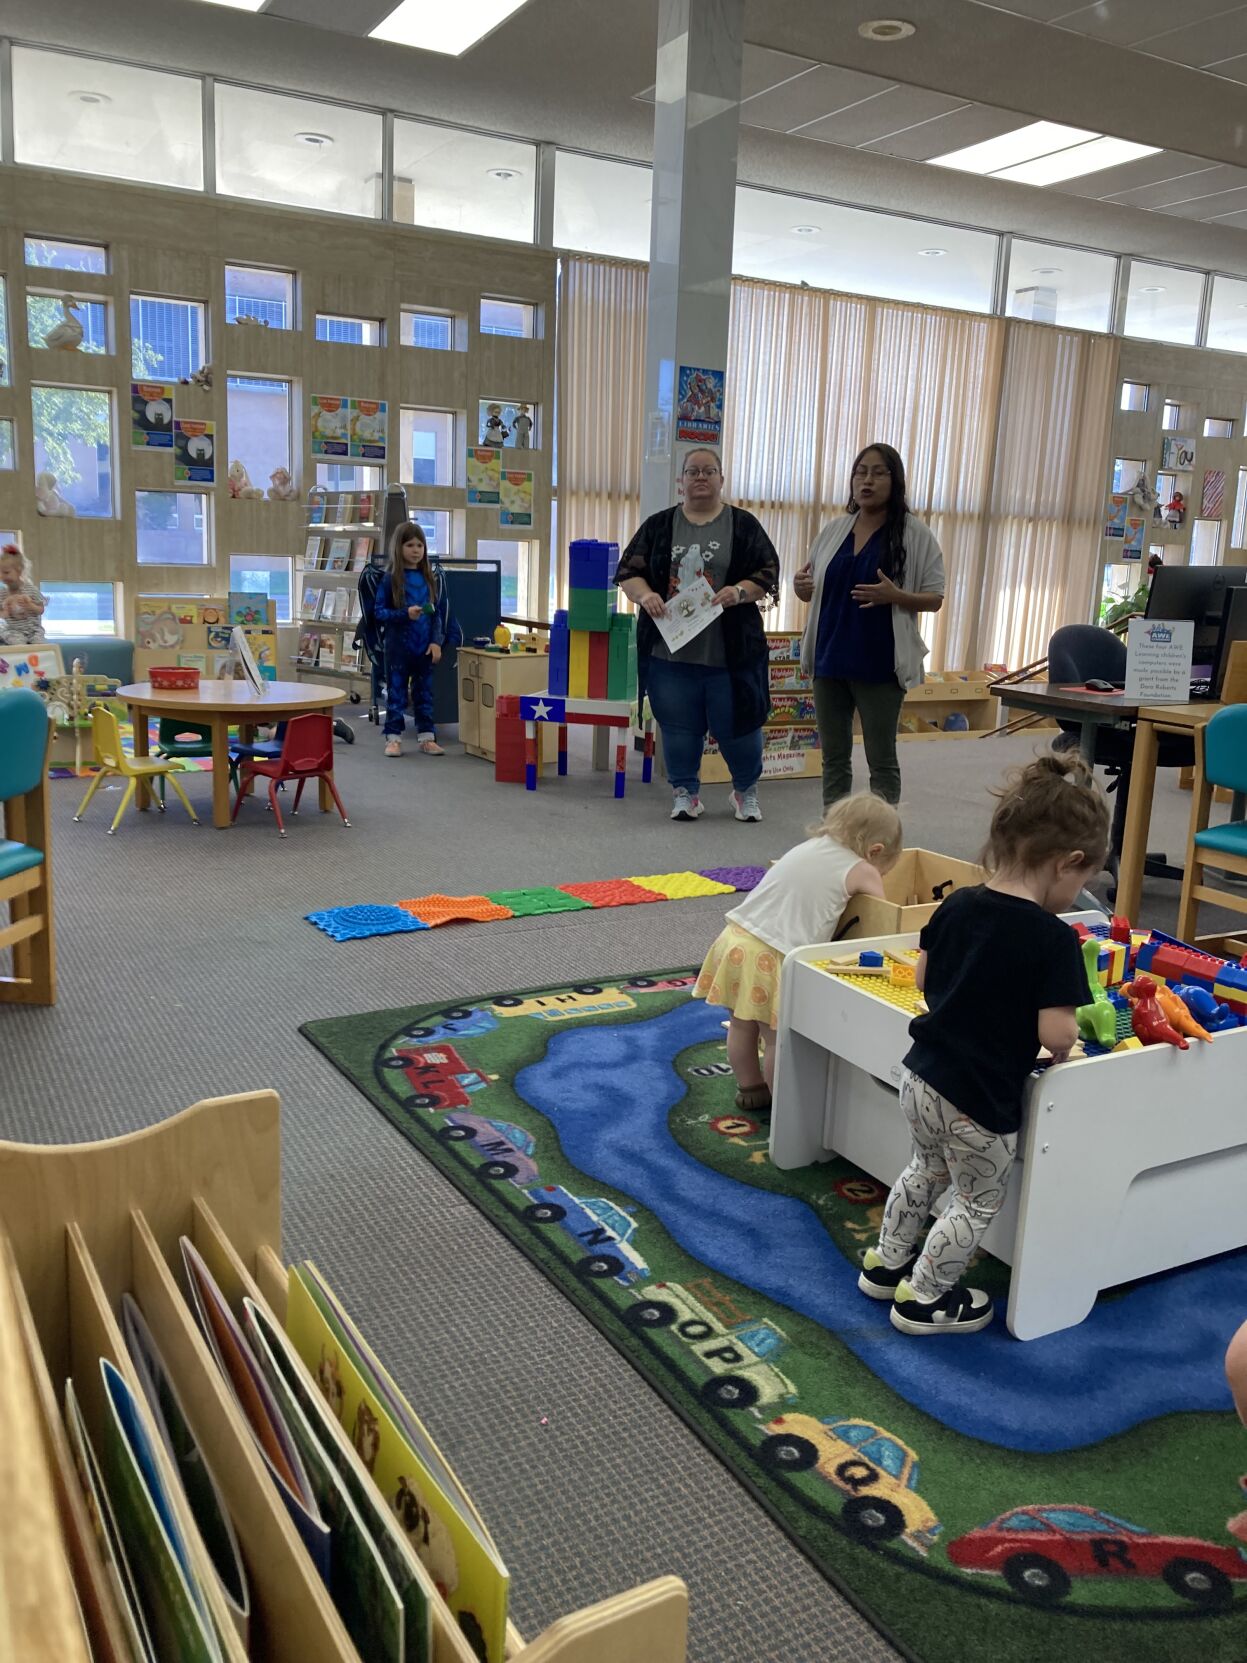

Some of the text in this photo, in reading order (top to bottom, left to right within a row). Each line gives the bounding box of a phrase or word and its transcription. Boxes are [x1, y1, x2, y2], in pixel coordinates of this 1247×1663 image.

[679, 420, 720, 431] LIBRARIES
[777, 752, 805, 761] Magazine
[782, 765, 794, 773] Only
[480, 1140, 515, 1156] M
[578, 1227, 616, 1247] N
[678, 1319, 744, 1364] O P
[835, 1460, 880, 1490] Q
[1090, 1538, 1136, 1569] R
